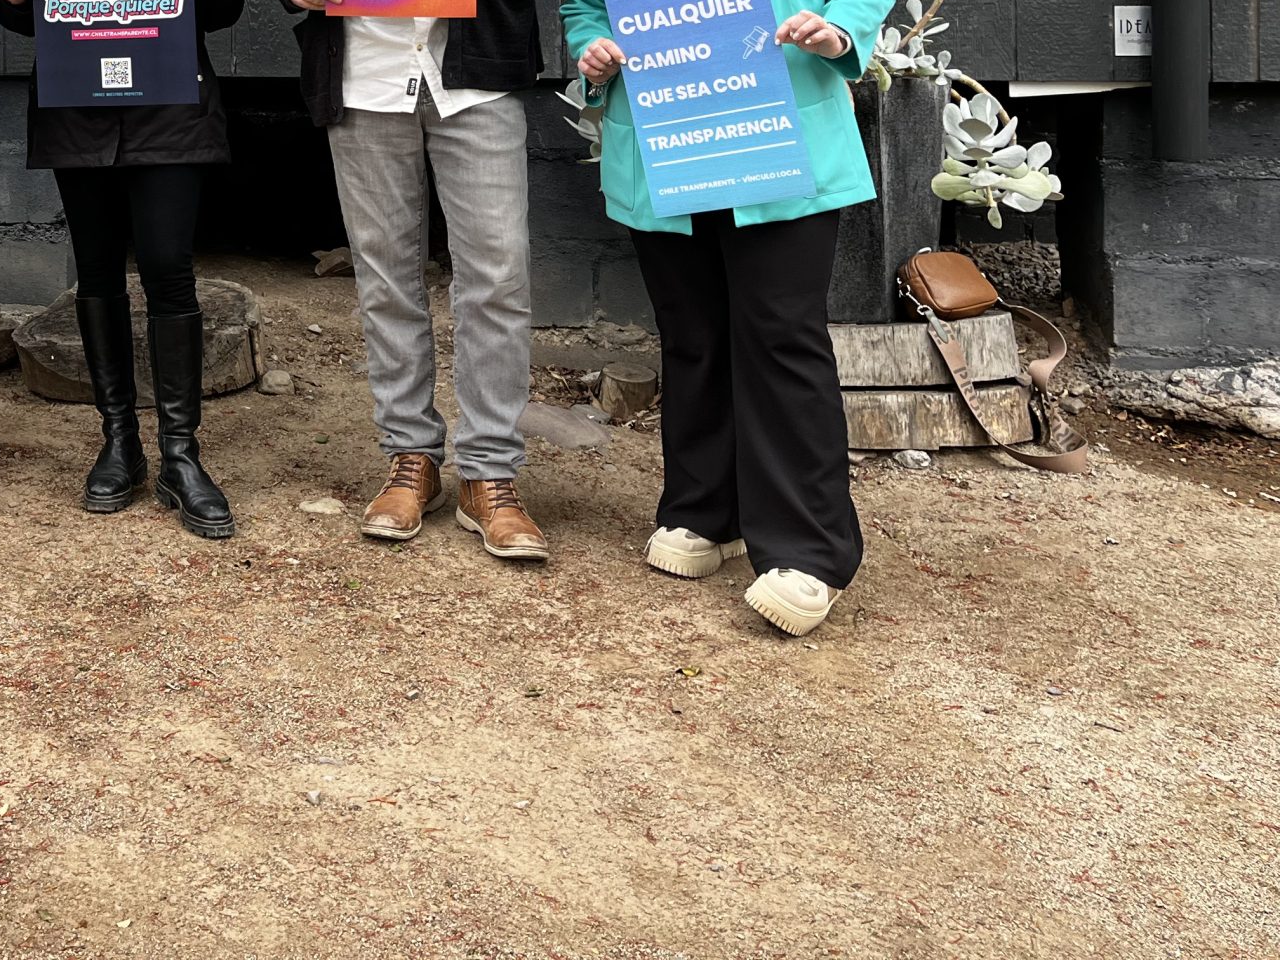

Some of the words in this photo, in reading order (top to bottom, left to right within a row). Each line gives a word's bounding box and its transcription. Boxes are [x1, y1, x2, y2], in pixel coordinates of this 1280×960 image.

[627, 43, 712, 72] CAMINO
[637, 88, 675, 108] QUE
[677, 80, 712, 100] SEA
[713, 72, 758, 93] CON
[647, 115, 793, 152] TRANSPARENCIA
[658, 186, 679, 196] CHILE
[679, 178, 736, 193] TRANSPARENTE
[742, 171, 776, 183] VÍNCULO
[776, 168, 802, 178] LOCAL
